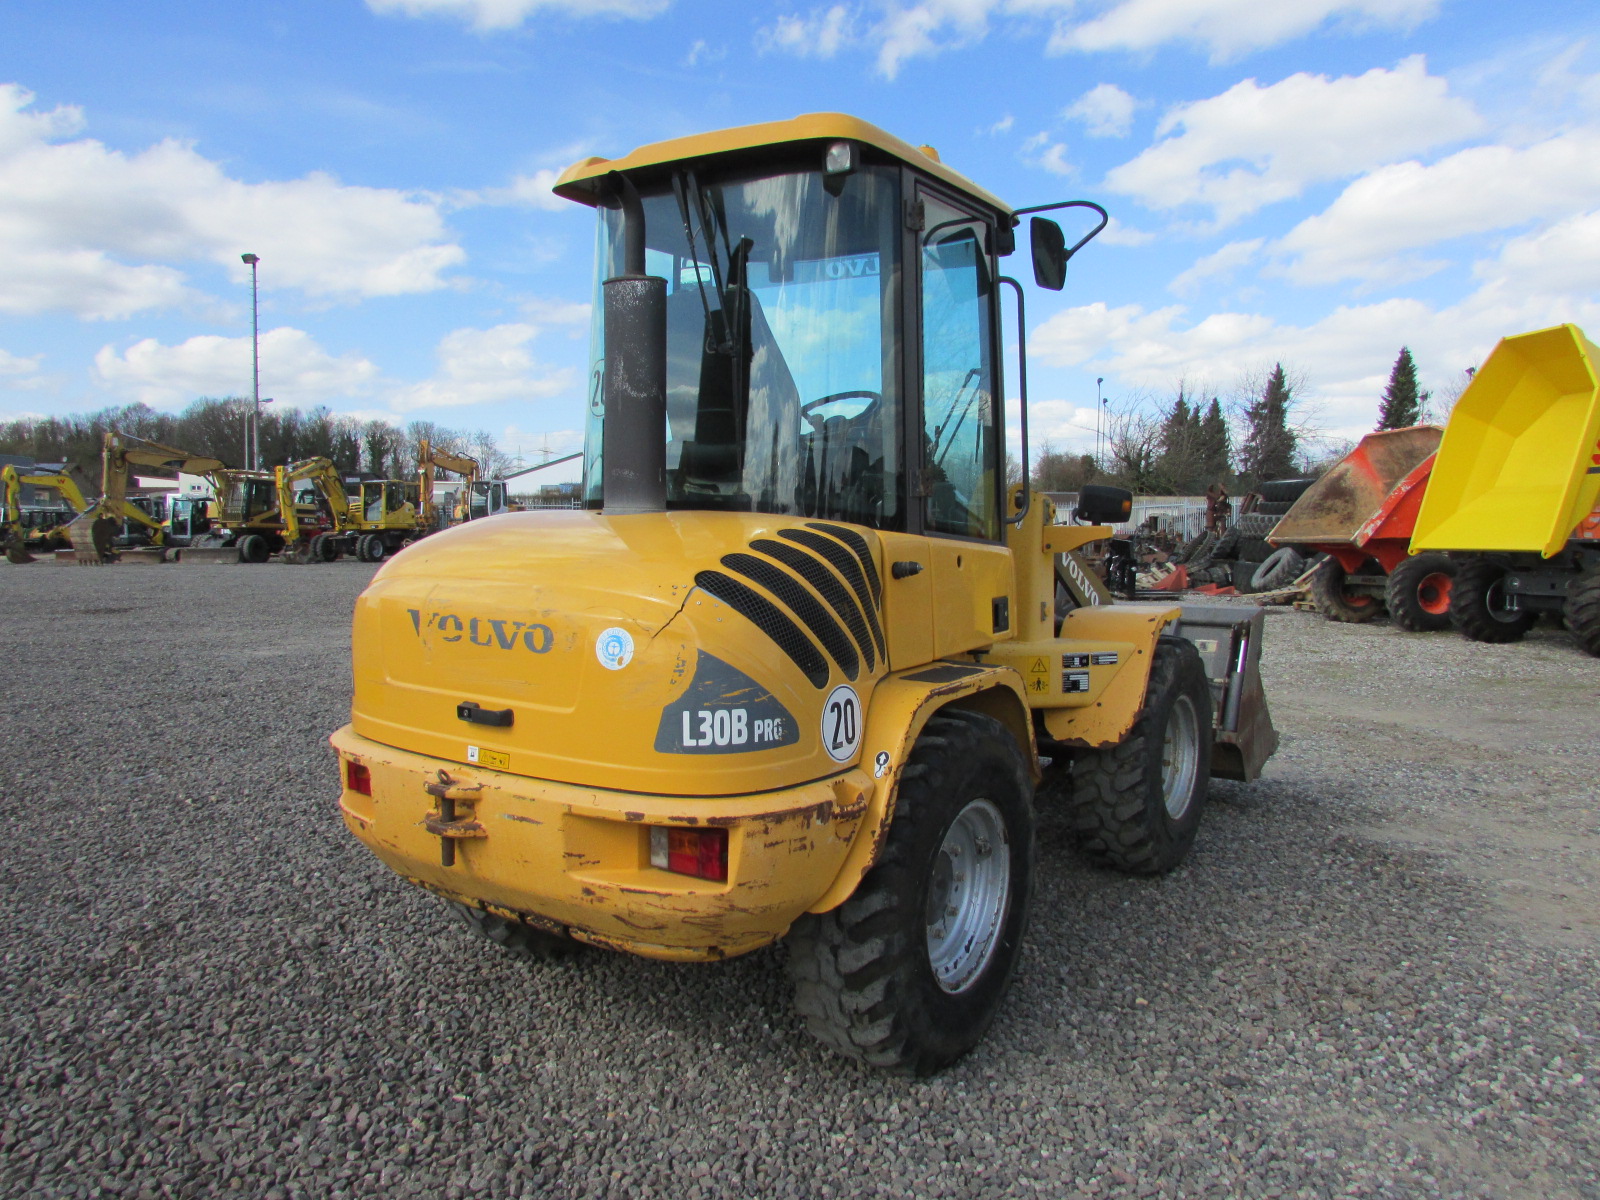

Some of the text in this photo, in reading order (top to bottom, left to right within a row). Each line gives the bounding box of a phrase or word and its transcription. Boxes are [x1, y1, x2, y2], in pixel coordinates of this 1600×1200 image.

[1062, 552, 1099, 606] VOLVO
[682, 709, 748, 746] L30B
[830, 698, 856, 750] 20
